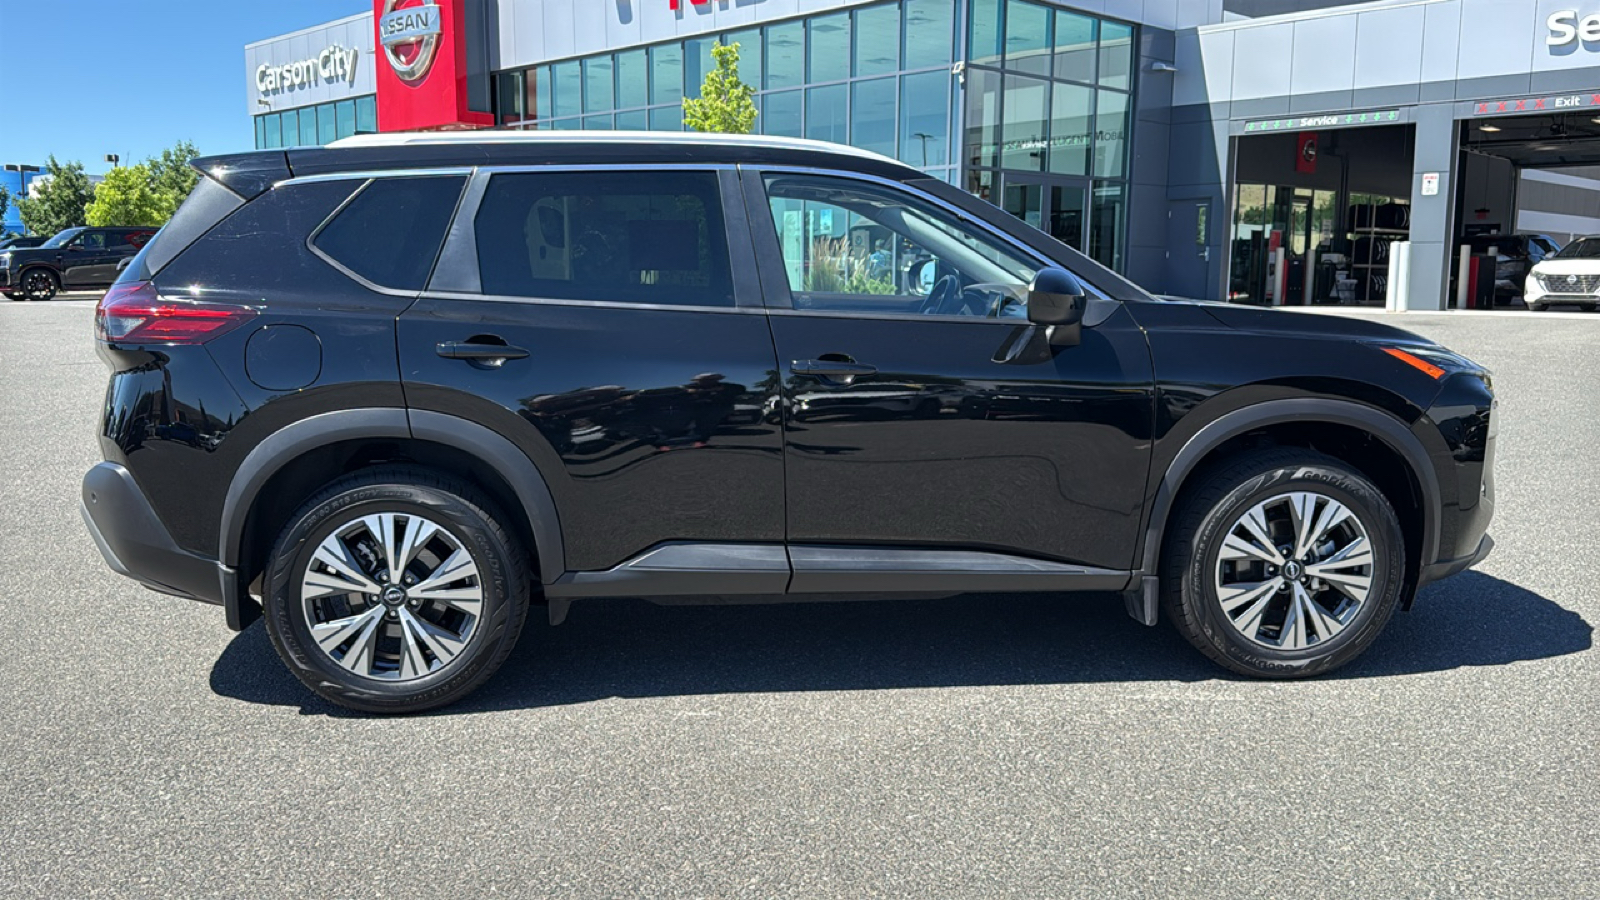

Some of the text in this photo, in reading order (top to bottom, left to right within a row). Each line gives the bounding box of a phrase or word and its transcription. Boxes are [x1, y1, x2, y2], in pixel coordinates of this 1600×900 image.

[256, 44, 358, 91] Carson City
[1555, 95, 1580, 107] Exit
[1300, 115, 1338, 127] Service
